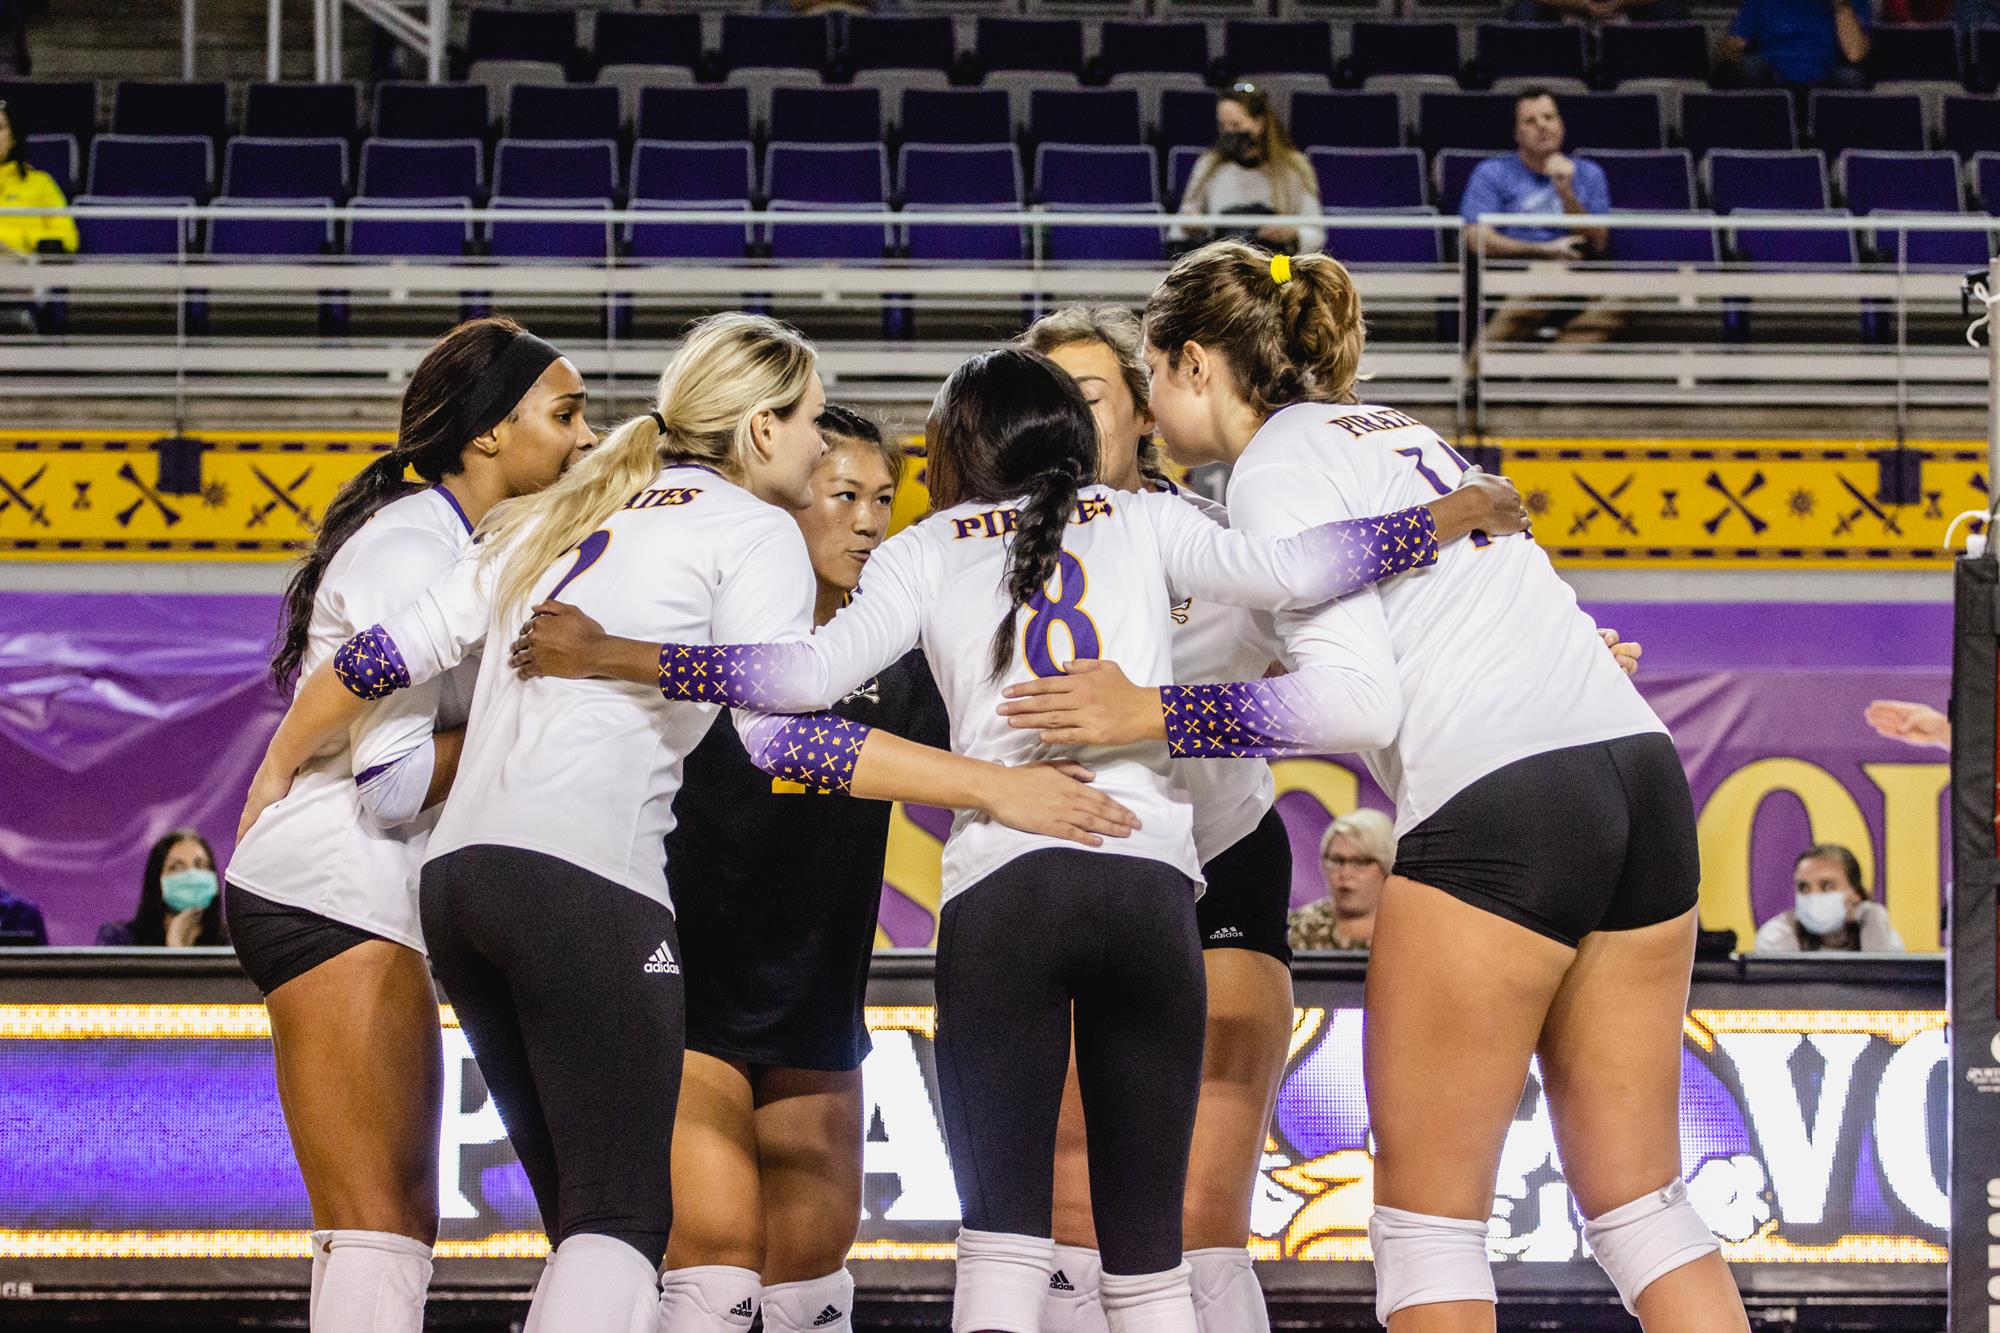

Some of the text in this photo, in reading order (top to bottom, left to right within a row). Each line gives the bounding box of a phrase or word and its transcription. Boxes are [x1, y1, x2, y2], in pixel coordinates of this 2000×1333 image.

[1209, 931, 1244, 940] adidas
[643, 960, 680, 975] adidas
[1049, 1279, 1075, 1291] didas
